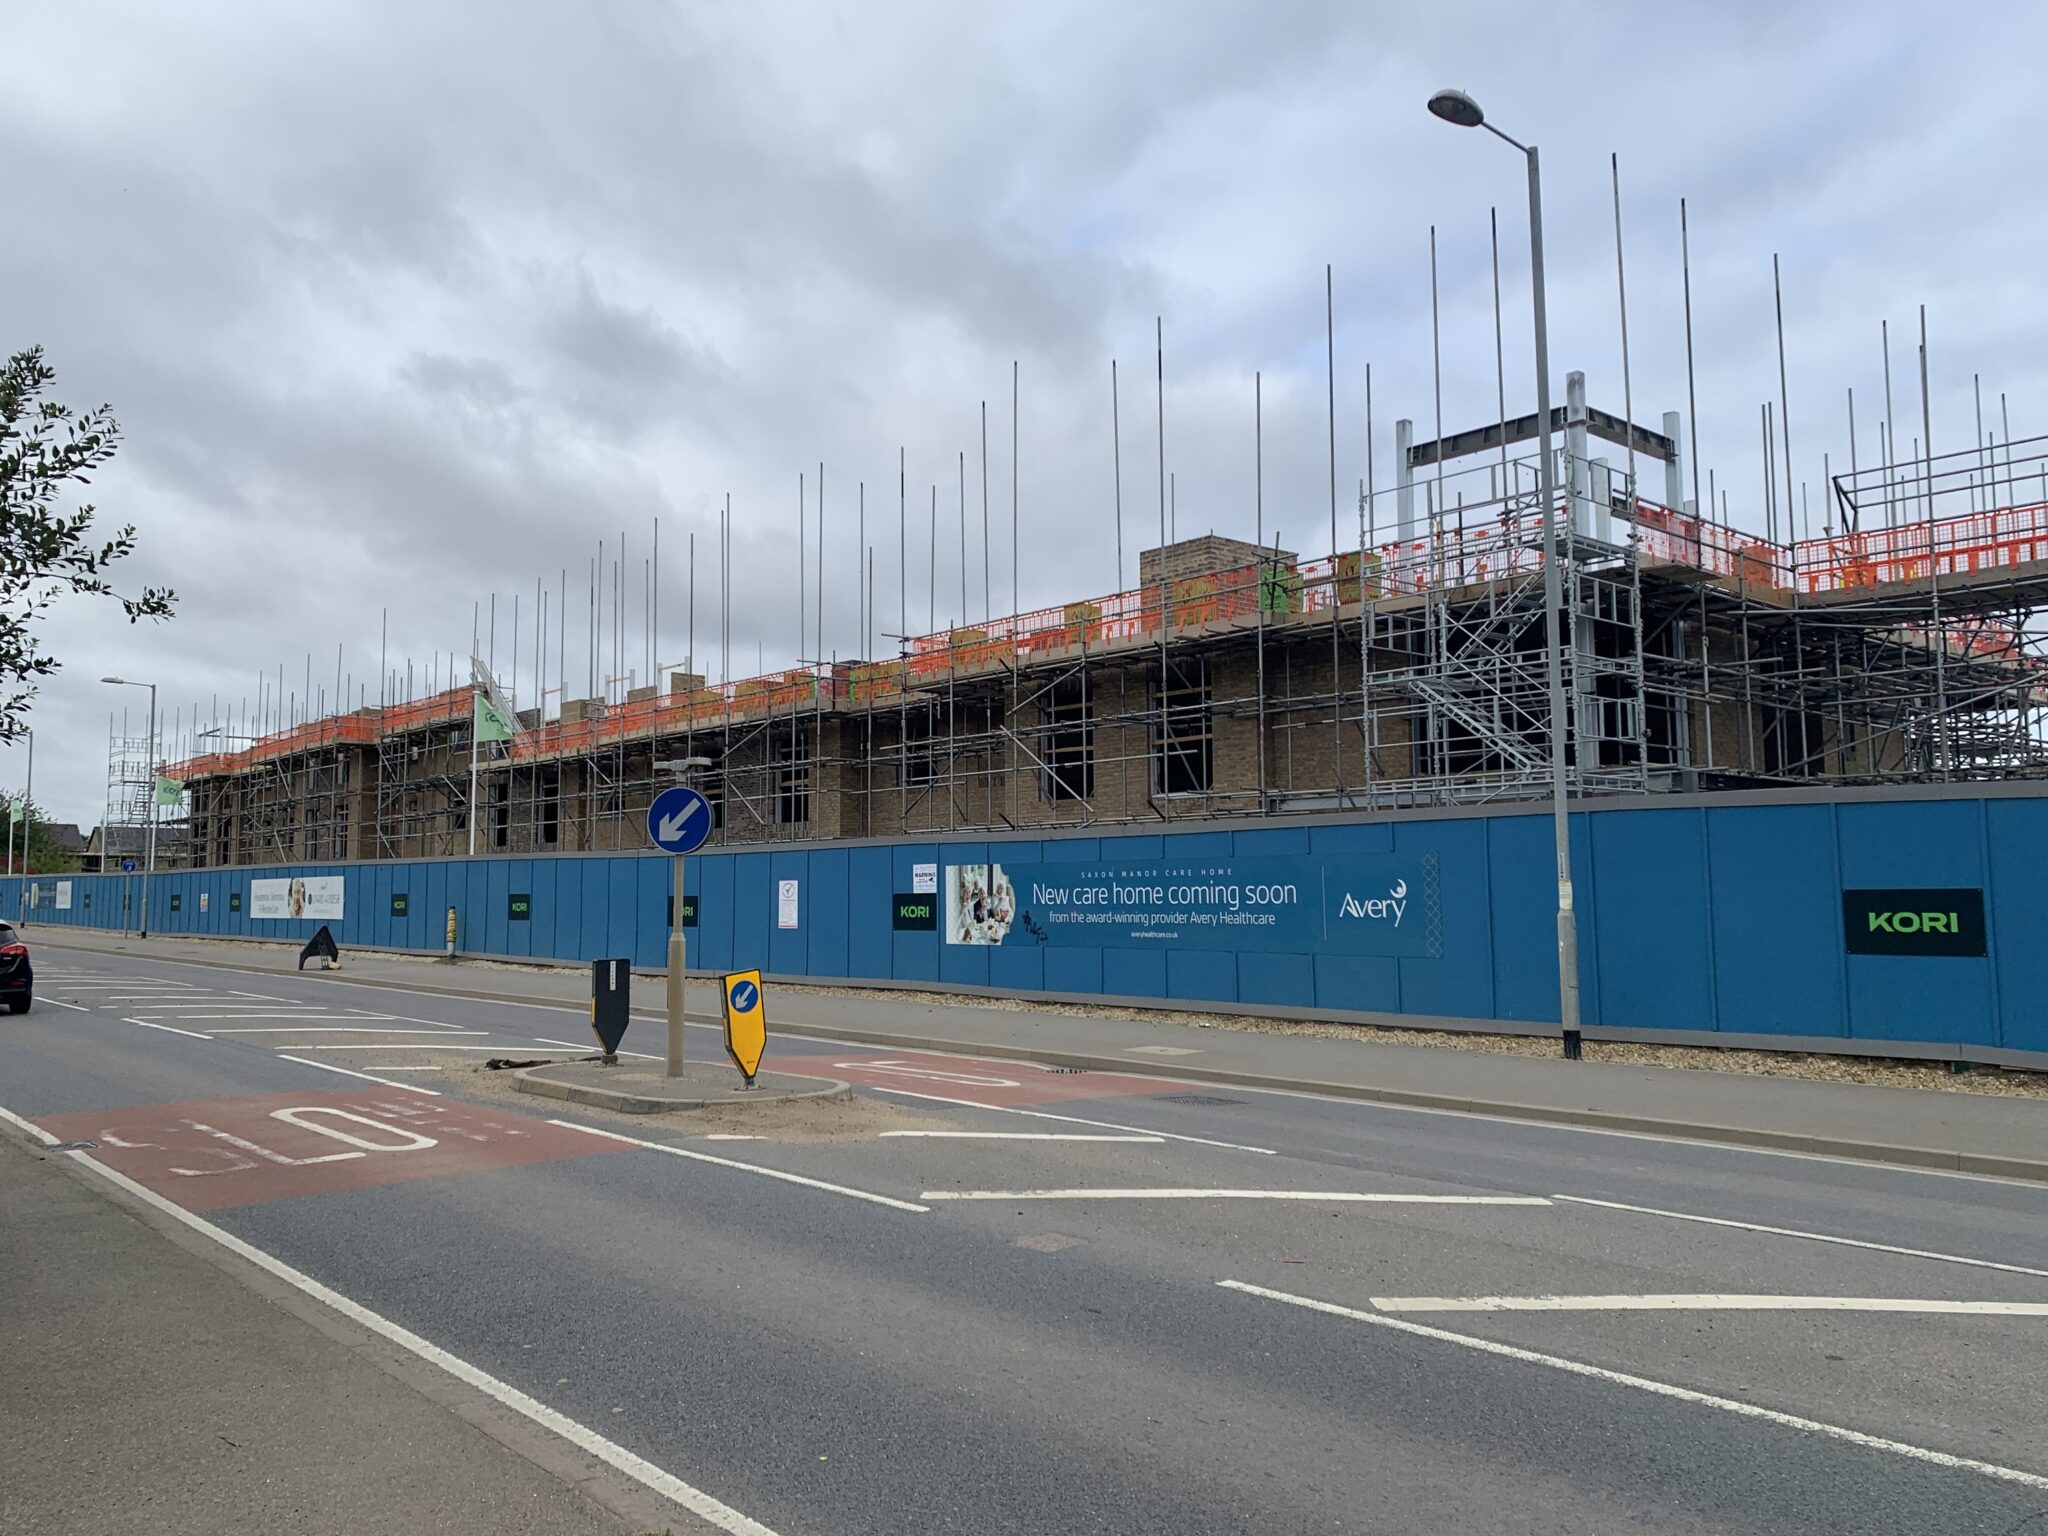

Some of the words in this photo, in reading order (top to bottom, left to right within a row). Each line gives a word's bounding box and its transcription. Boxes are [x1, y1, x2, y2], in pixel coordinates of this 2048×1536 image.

[1081, 871, 1114, 879] SAXON
[1121, 870, 1157, 878] MANOR
[1165, 869, 1192, 877] CARE
[1201, 868, 1232, 876] HOME
[1033, 883, 1069, 905] New
[1073, 887, 1108, 905] care
[1113, 882, 1164, 905] home
[1168, 880, 1240, 911] coming
[1245, 884, 1297, 905] soon
[512, 902, 527, 912] KORI
[900, 905, 929, 918] KORI
[1339, 891, 1407, 928] Avery
[1049, 911, 1069, 923] from
[1071, 911, 1085, 923] the
[1086, 911, 1149, 926] award-winning
[1151, 911, 1188, 926] provider
[1190, 911, 1218, 927] Avery
[1220, 911, 1276, 925] Healthcare
[1868, 912, 1960, 933] KORI
